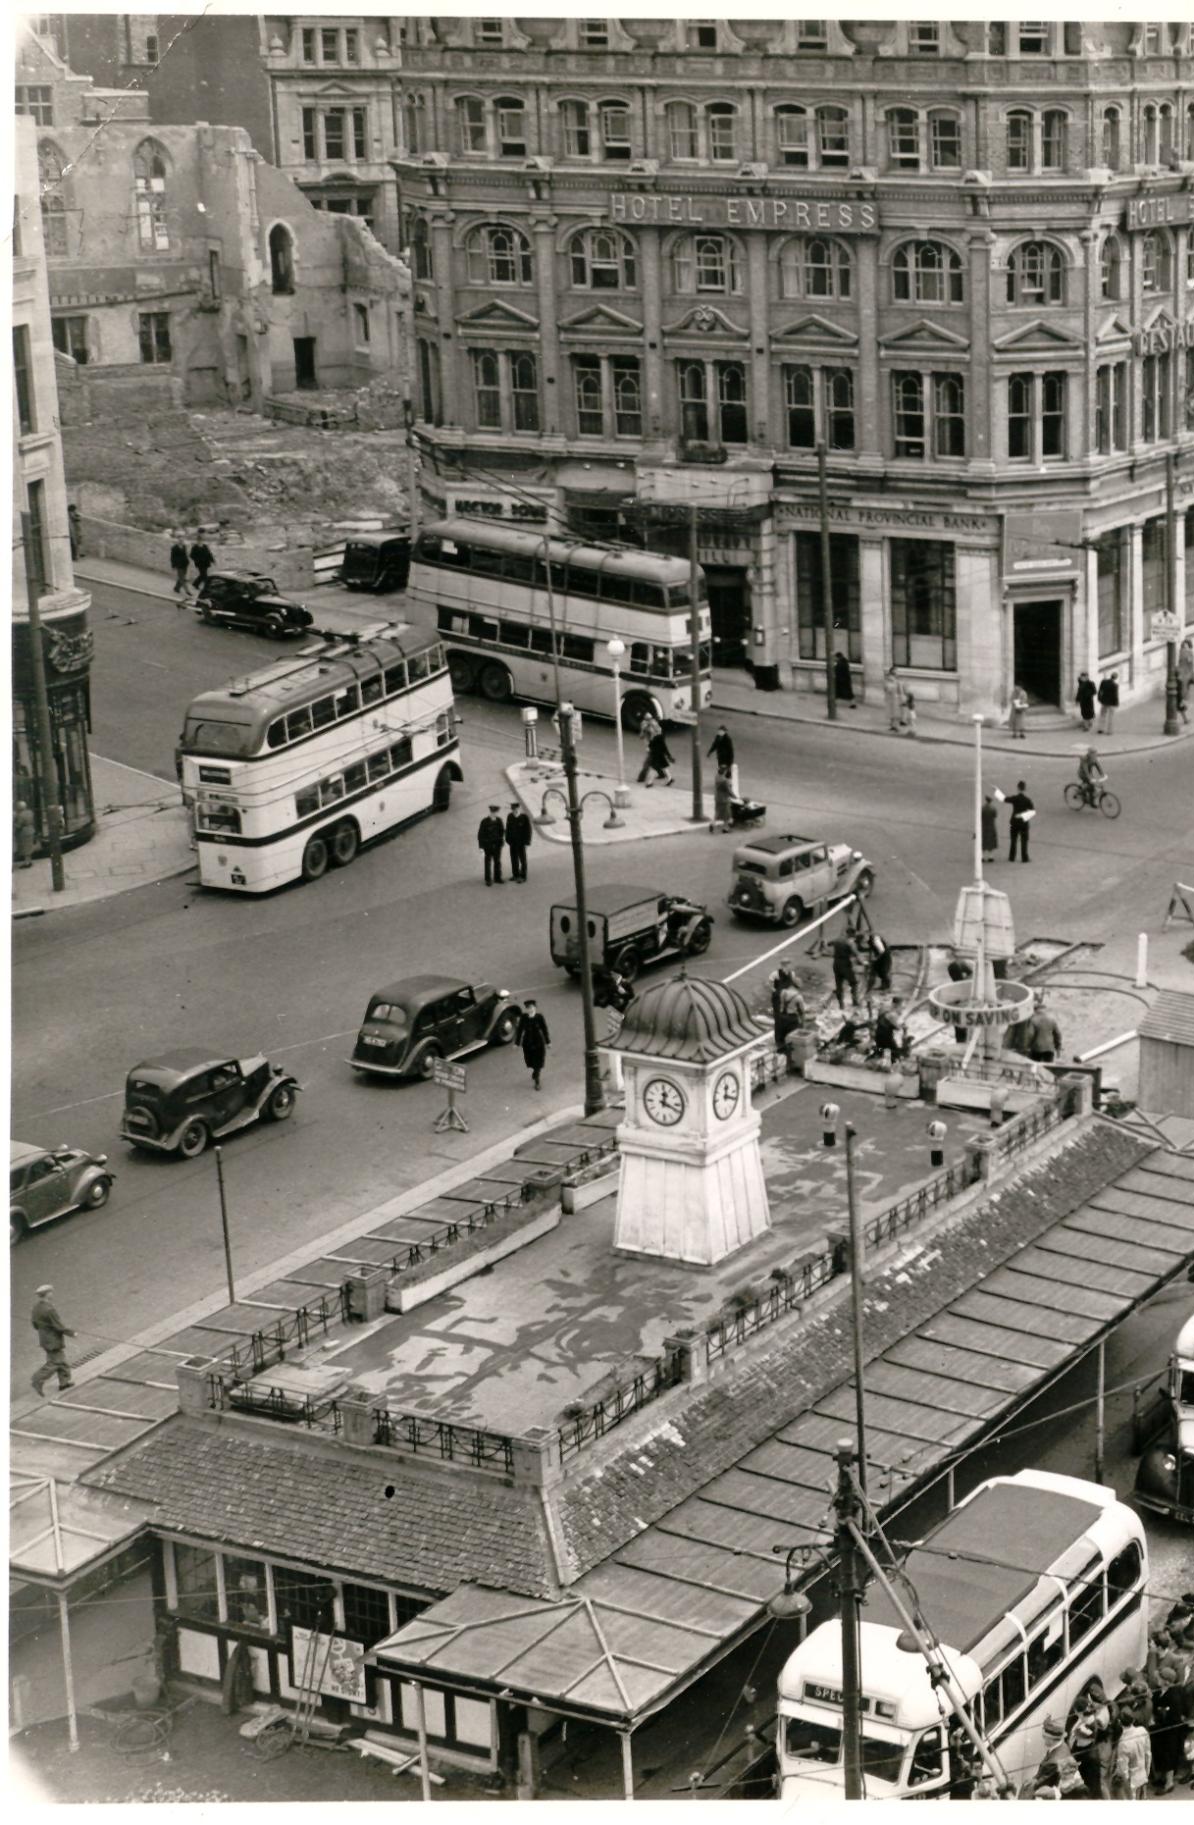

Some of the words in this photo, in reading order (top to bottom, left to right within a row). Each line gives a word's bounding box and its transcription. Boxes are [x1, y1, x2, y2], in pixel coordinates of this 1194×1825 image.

[611, 193, 703, 221] HOTEL
[726, 199, 876, 229] EMPRESS
[1129, 197, 1174, 222] HOTEL
[784, 505, 851, 522] NATIONAL
[858, 510, 936, 527] PROVINCIAL
[943, 516, 981, 530] BANK
[942, 1008, 961, 1024] ON
[966, 1007, 1020, 1026] SAVING
